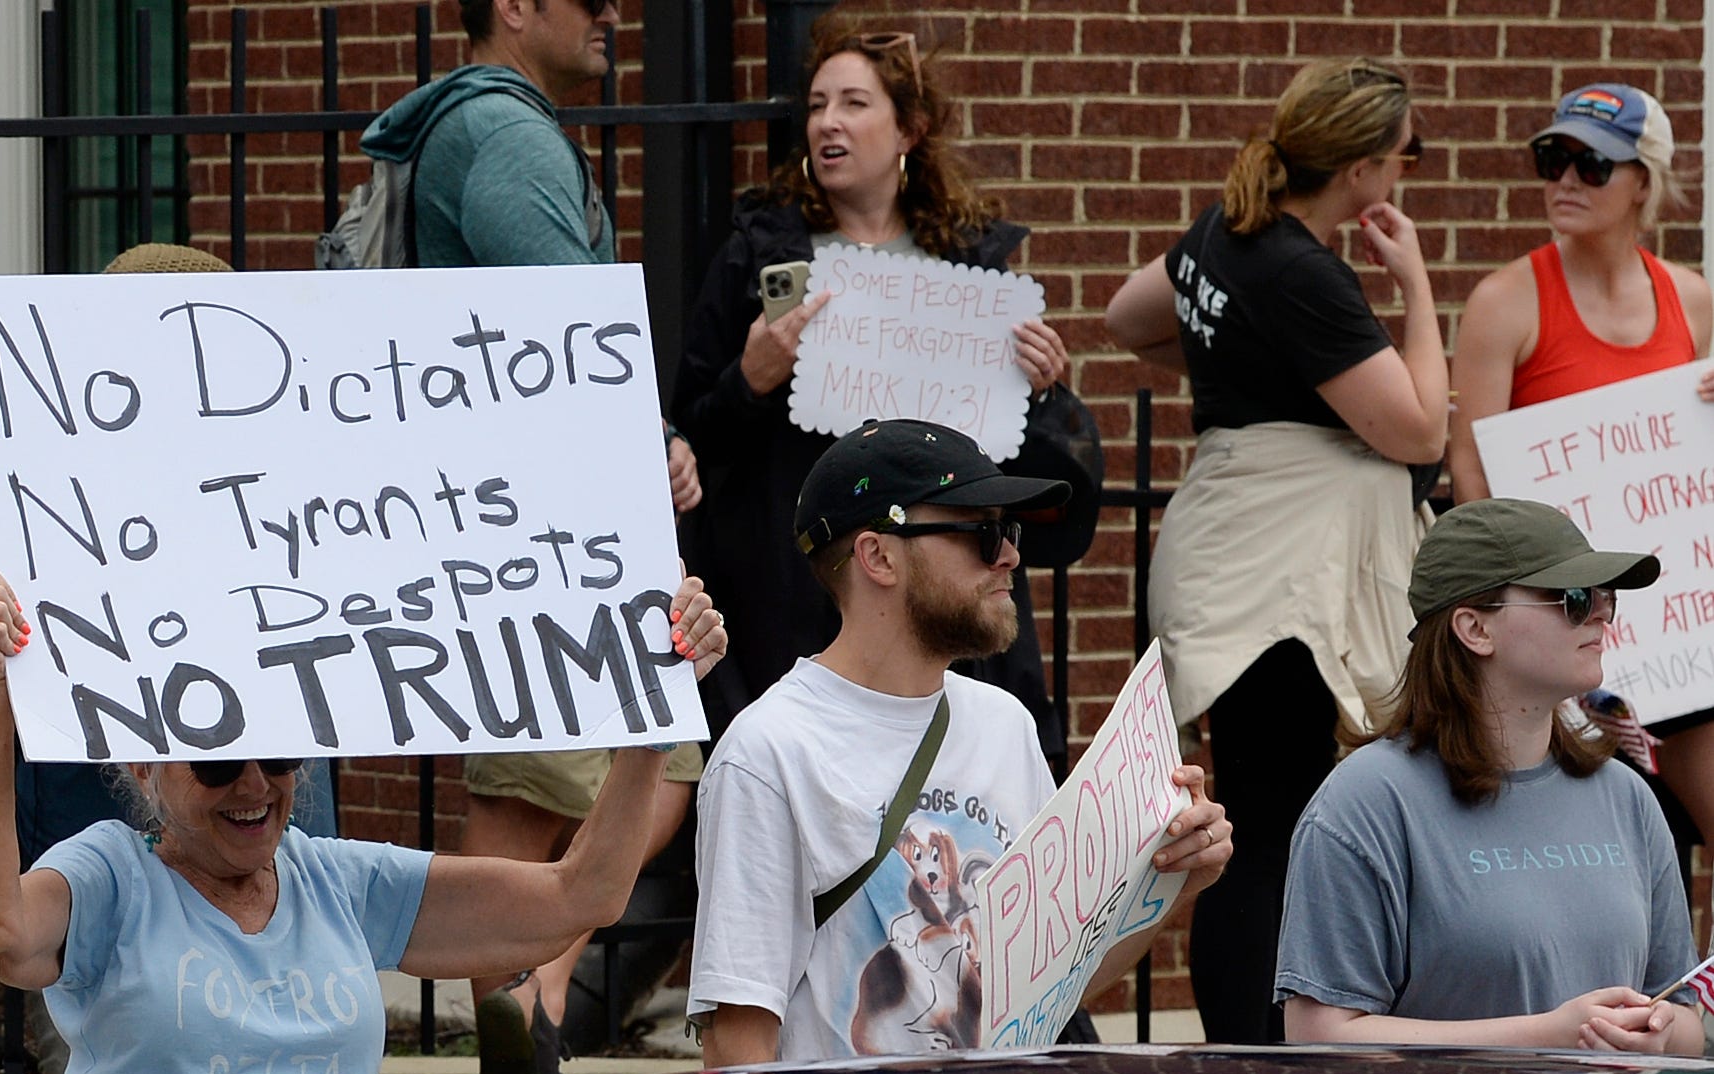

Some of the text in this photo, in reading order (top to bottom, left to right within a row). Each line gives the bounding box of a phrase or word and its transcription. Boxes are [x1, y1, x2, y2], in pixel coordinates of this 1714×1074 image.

[831, 258, 1014, 319] SOME PEOPLE
[159, 300, 641, 424] Dictators
[812, 292, 1019, 371] HAVE FORGOTTEN
[820, 361, 991, 437] MARK 12:31
[1529, 431, 1579, 482] IF
[9, 467, 519, 581] No Tyrants
[37, 523, 623, 676] No Despots
[72, 590, 686, 759] NO TRUMP
[913, 788, 959, 815] OGS
[986, 658, 1182, 1030] PROTEST
[1468, 843, 1626, 875] SEASIDE
[176, 946, 373, 1037] FOXTROT
